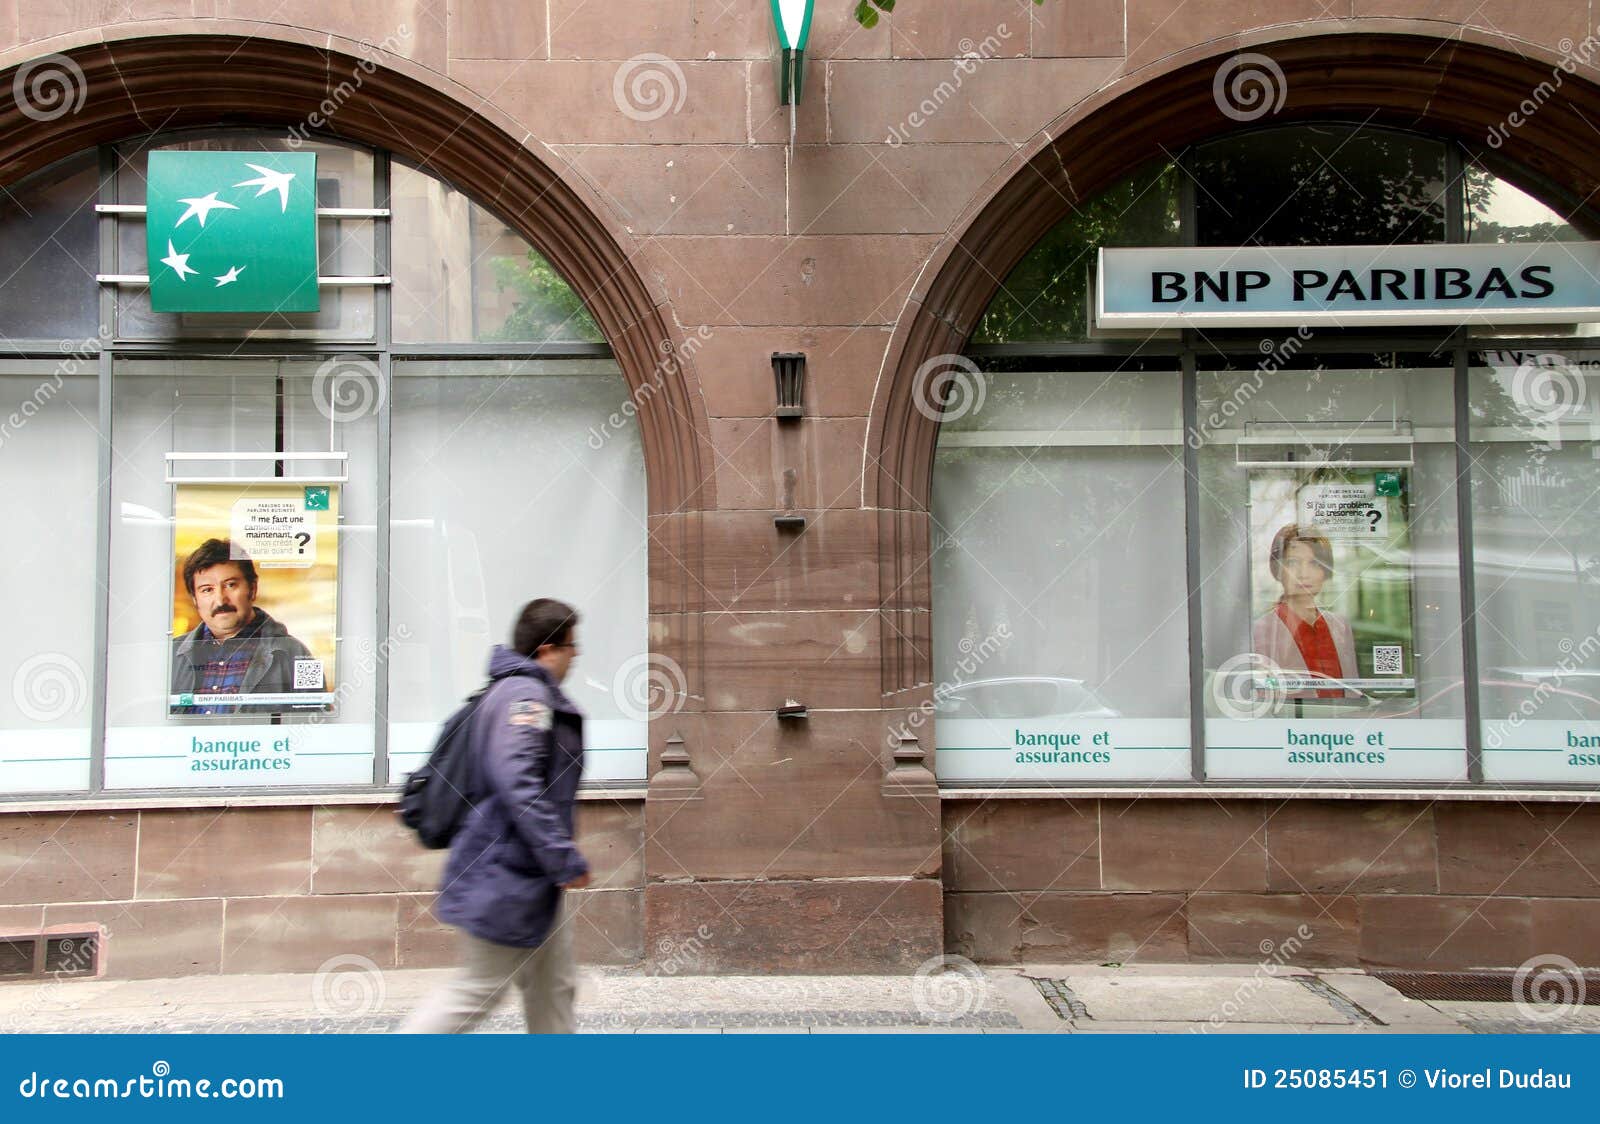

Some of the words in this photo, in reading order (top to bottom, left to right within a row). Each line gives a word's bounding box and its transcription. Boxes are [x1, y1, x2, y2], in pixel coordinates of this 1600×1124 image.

[1151, 270, 1271, 303] BNP
[1293, 265, 1554, 302] PARIBAS
[272, 515, 288, 524] faut
[246, 531, 293, 540] maintenant,
[294, 532, 311, 554] ?
[192, 736, 261, 757] banque
[273, 738, 290, 752] et
[1015, 729, 1081, 751] banque
[1093, 731, 1110, 746] et
[1288, 729, 1355, 751] banque
[1367, 731, 1384, 746] et
[191, 758, 291, 771] assurances
[1015, 751, 1111, 763] assurances
[1288, 751, 1385, 763] assurances
